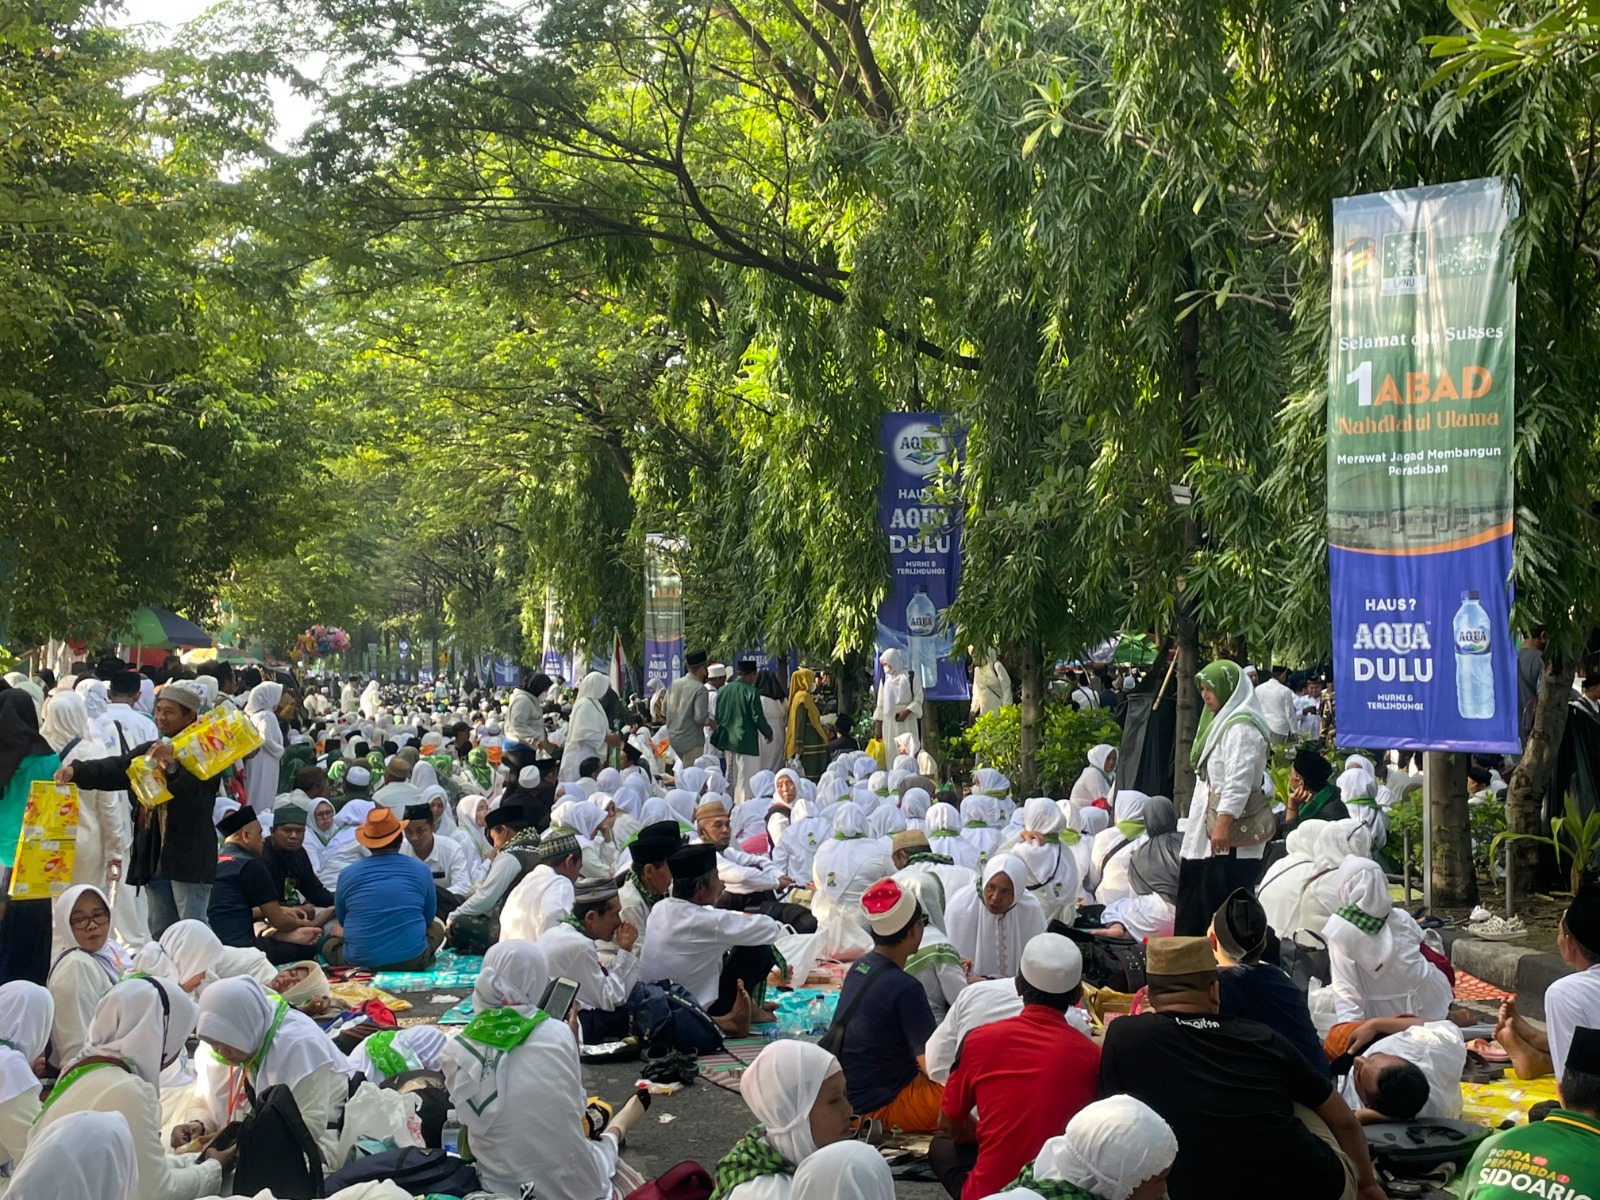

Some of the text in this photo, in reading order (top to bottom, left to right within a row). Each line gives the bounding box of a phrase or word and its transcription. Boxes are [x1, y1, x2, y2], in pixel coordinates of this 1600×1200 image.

[1340, 332, 1406, 351] Selamat
[1445, 325, 1504, 342] Sukses
[1373, 365, 1493, 406] ABAD
[1436, 410, 1499, 430] Ulama
[1337, 447, 1501, 464] Merawat Jagad Membangun
[1388, 464, 1448, 476] Peradaban
[889, 535, 950, 553] DULU
[1365, 598, 1417, 611] HAUS?
[910, 617, 933, 627] AQUA
[1353, 621, 1432, 655] AQUA
[1459, 631, 1487, 643] AQUA
[1353, 657, 1434, 682] DULU
[1377, 694, 1405, 702] MURNI
[1367, 702, 1424, 711] TERLINDUNGI
[1488, 1148, 1531, 1162] POPDA
